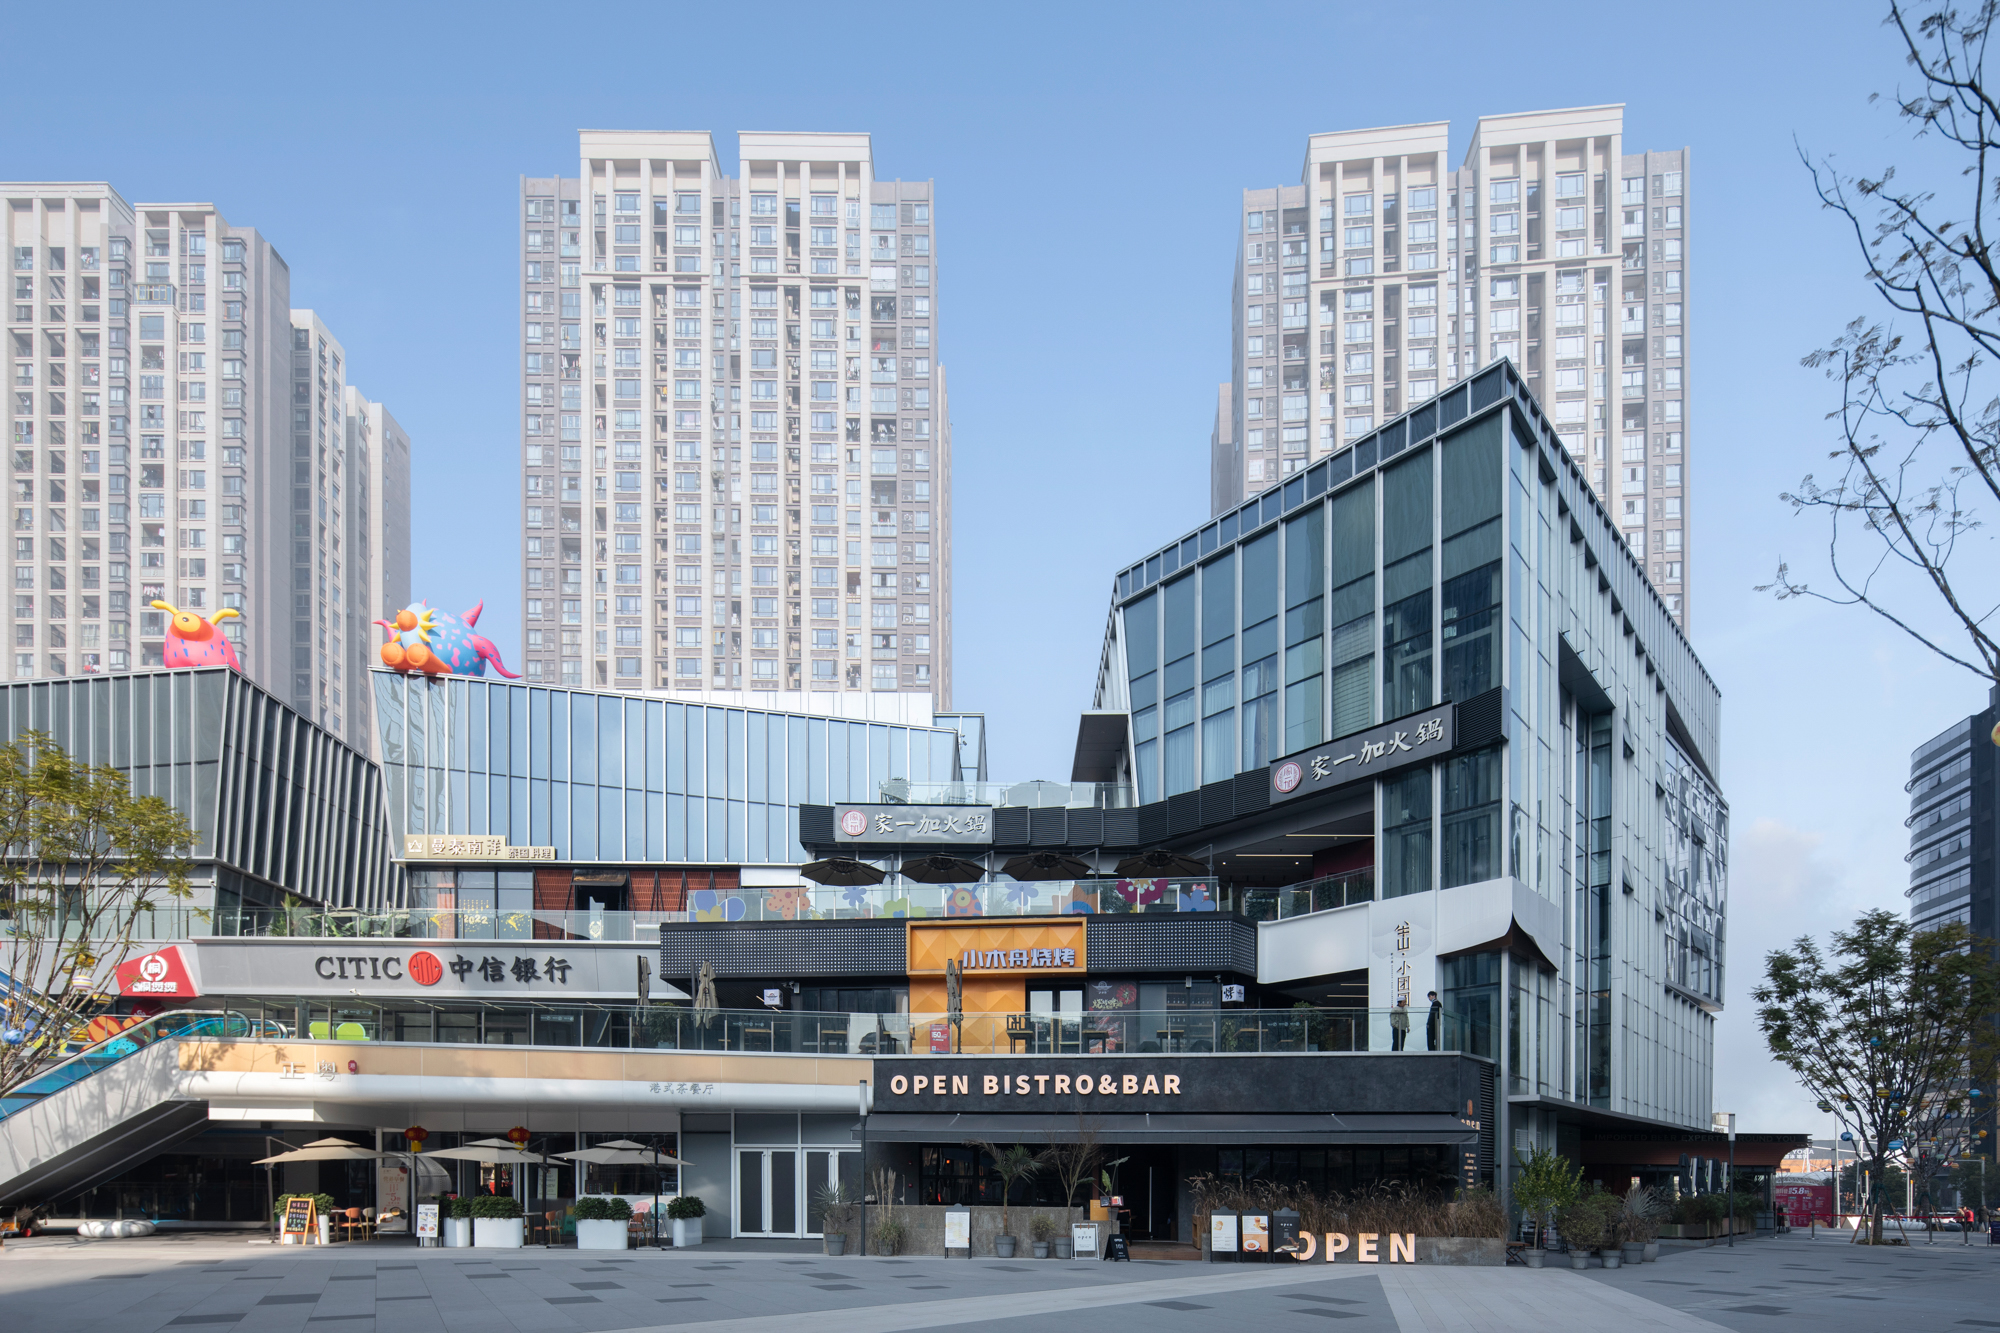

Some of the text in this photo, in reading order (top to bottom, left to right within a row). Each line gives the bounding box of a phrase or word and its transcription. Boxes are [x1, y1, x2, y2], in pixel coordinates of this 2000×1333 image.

[431, 838, 502, 856] 曼泰南洋
[508, 848, 552, 859] 泰国料理
[463, 914, 489, 925] 2022
[963, 948, 1075, 968] 小木舟烧烤
[315, 956, 403, 980] CITIC
[448, 954, 573, 984] 中信银行
[649, 1082, 714, 1095] 港式茶餐厅
[890, 1074, 1181, 1095] OPEN BISTRO&BAR
[1594, 1133, 1796, 1143] IMPORTED BEER EXPERTS ROUND YOU
[1290, 1230, 1416, 1263] OPEN
